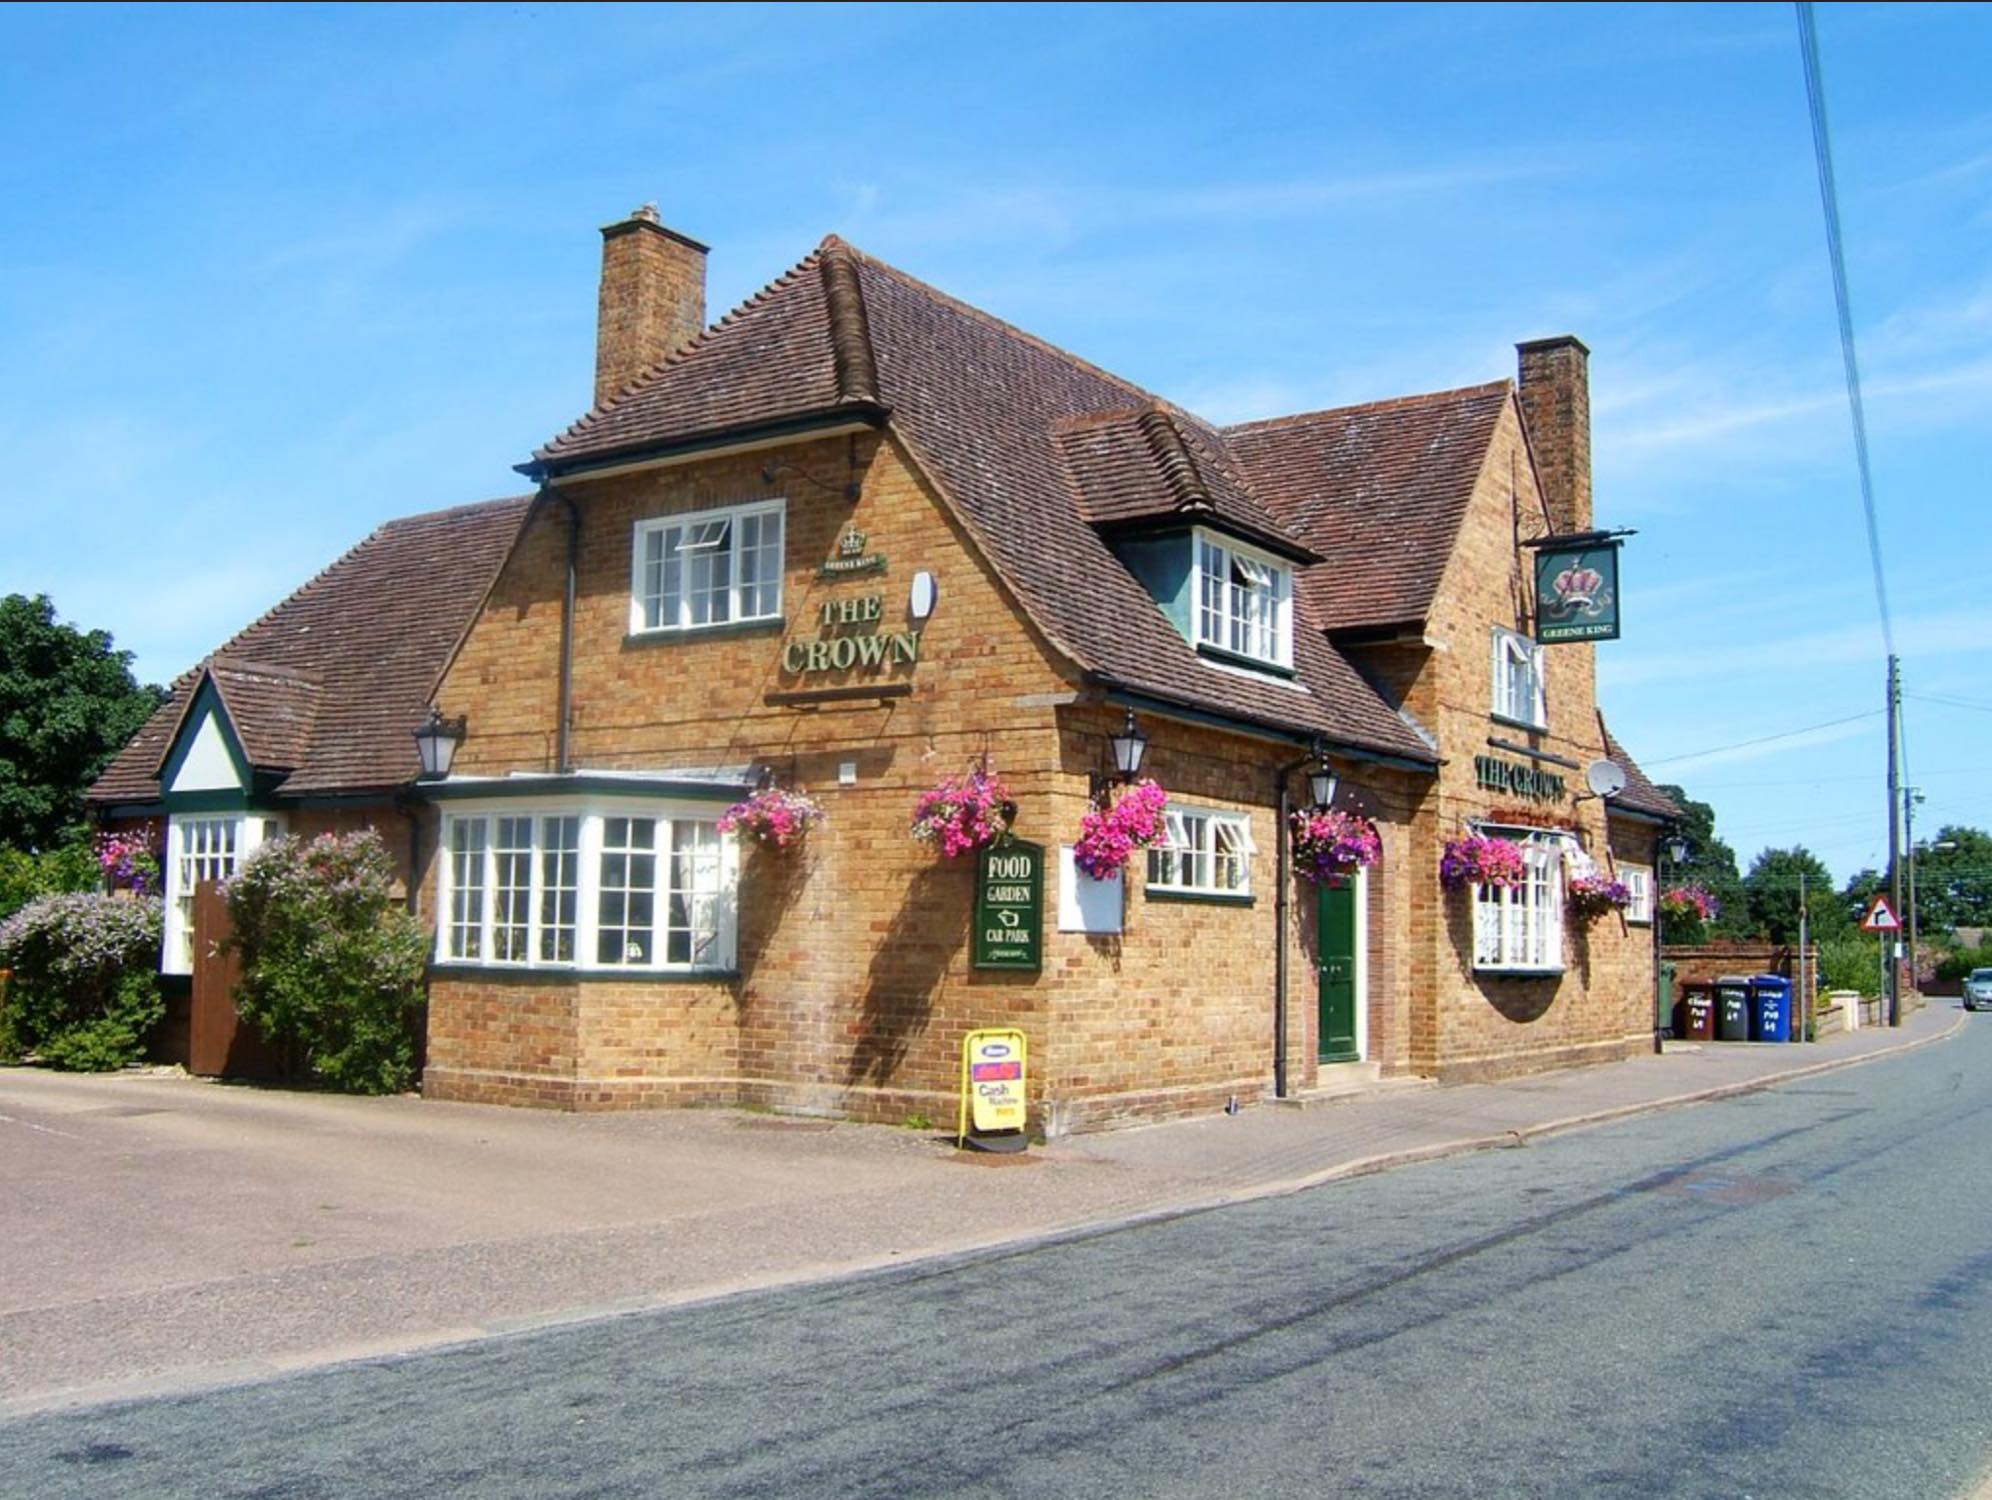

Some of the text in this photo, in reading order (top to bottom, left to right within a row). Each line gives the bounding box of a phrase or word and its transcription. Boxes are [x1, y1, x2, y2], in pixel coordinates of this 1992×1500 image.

[822, 596, 881, 625] THE
[1543, 624, 1613, 638] GREENE KING
[783, 631, 920, 673] CROWN
[988, 856, 1031, 878] FOOD
[986, 886, 1031, 902] GARDEN
[986, 929, 1003, 942] CAR
